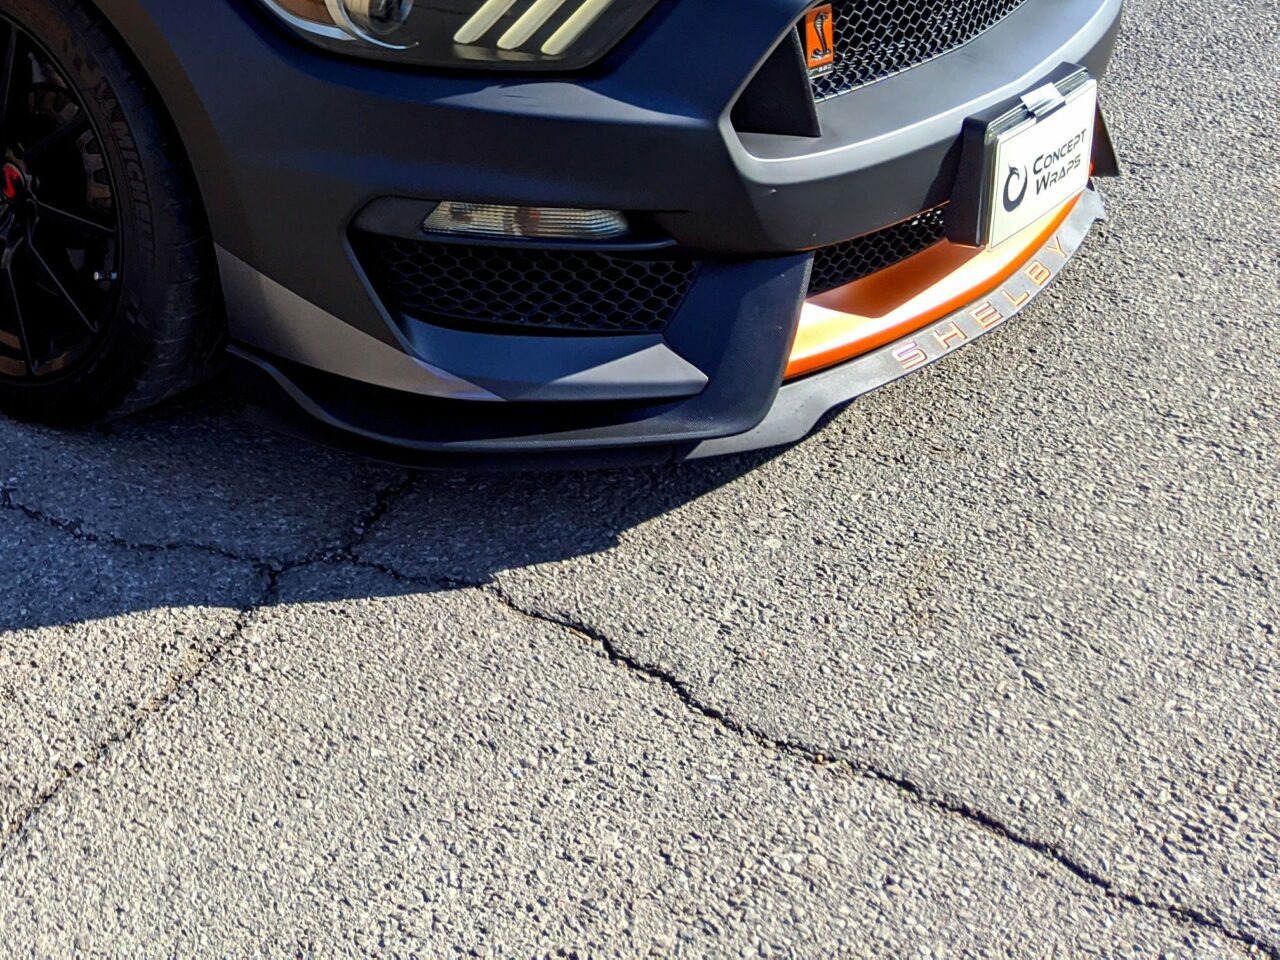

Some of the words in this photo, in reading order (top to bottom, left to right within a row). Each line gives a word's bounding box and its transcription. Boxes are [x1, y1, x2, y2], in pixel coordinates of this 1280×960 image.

[1032, 128, 1087, 175] CONCEPT
[1036, 153, 1081, 195] WRAPS
[892, 235, 1068, 370] SHELBY
